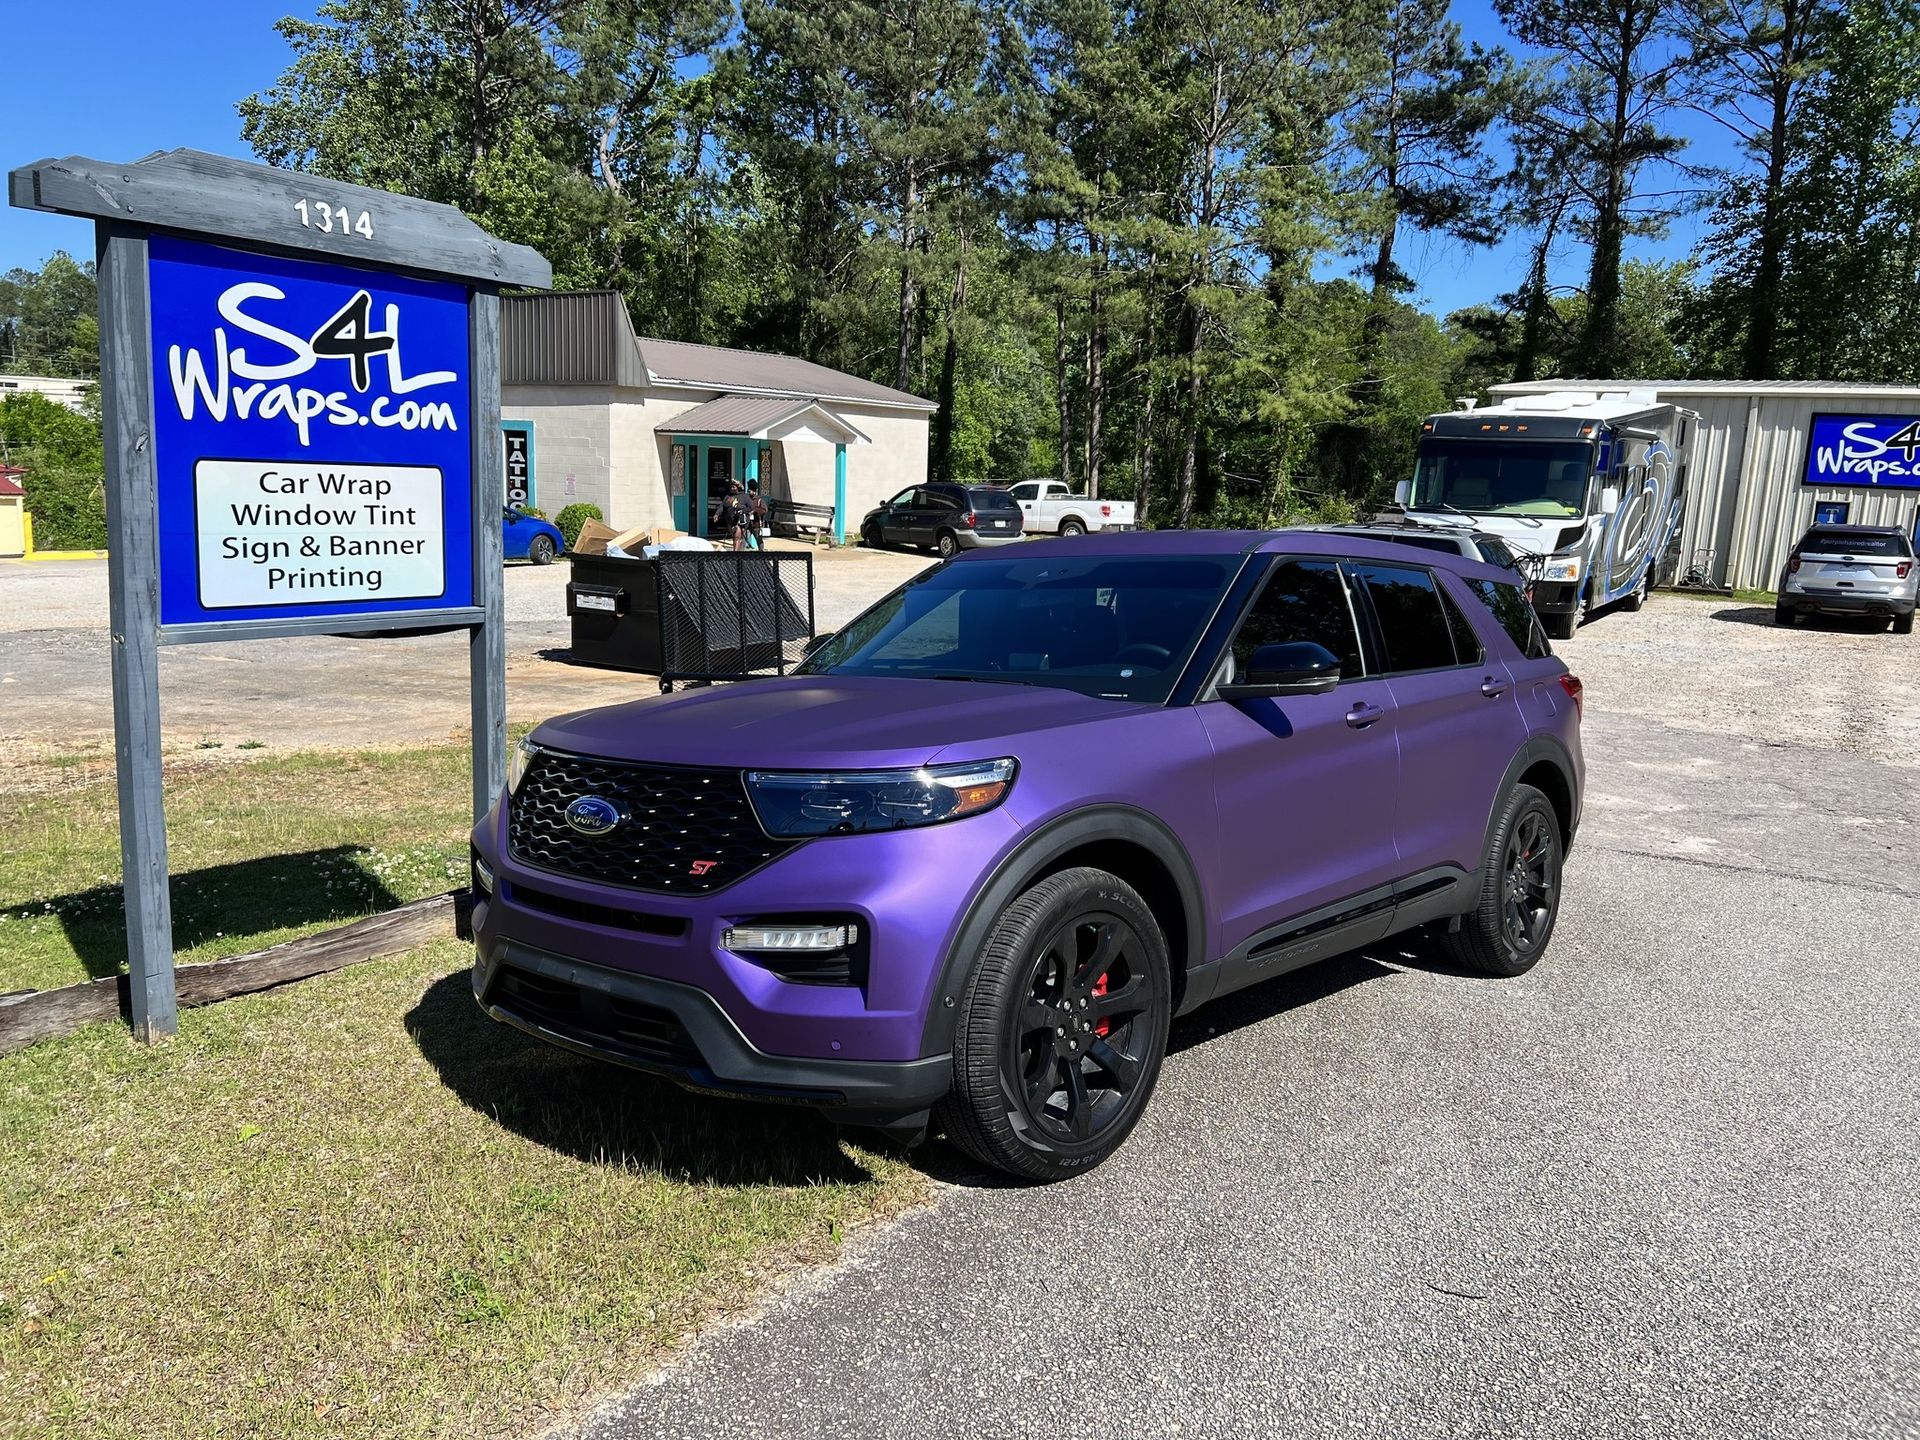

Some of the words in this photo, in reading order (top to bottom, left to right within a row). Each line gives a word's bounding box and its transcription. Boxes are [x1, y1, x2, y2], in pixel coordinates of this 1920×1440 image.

[293, 198, 374, 240] 1314
[217, 281, 457, 394] S4L
[168, 326, 458, 447] Wraps.com
[259, 471, 309, 494] Car
[317, 473, 391, 500] Wrap
[231, 503, 356, 526] Window
[364, 504, 416, 525] Tint
[222, 536, 290, 564] Sign
[299, 535, 321, 557] &
[330, 535, 426, 557] Banner
[268, 566, 382, 591] Printing
[573, 804, 604, 827] Ford
[689, 860, 718, 875] ST
